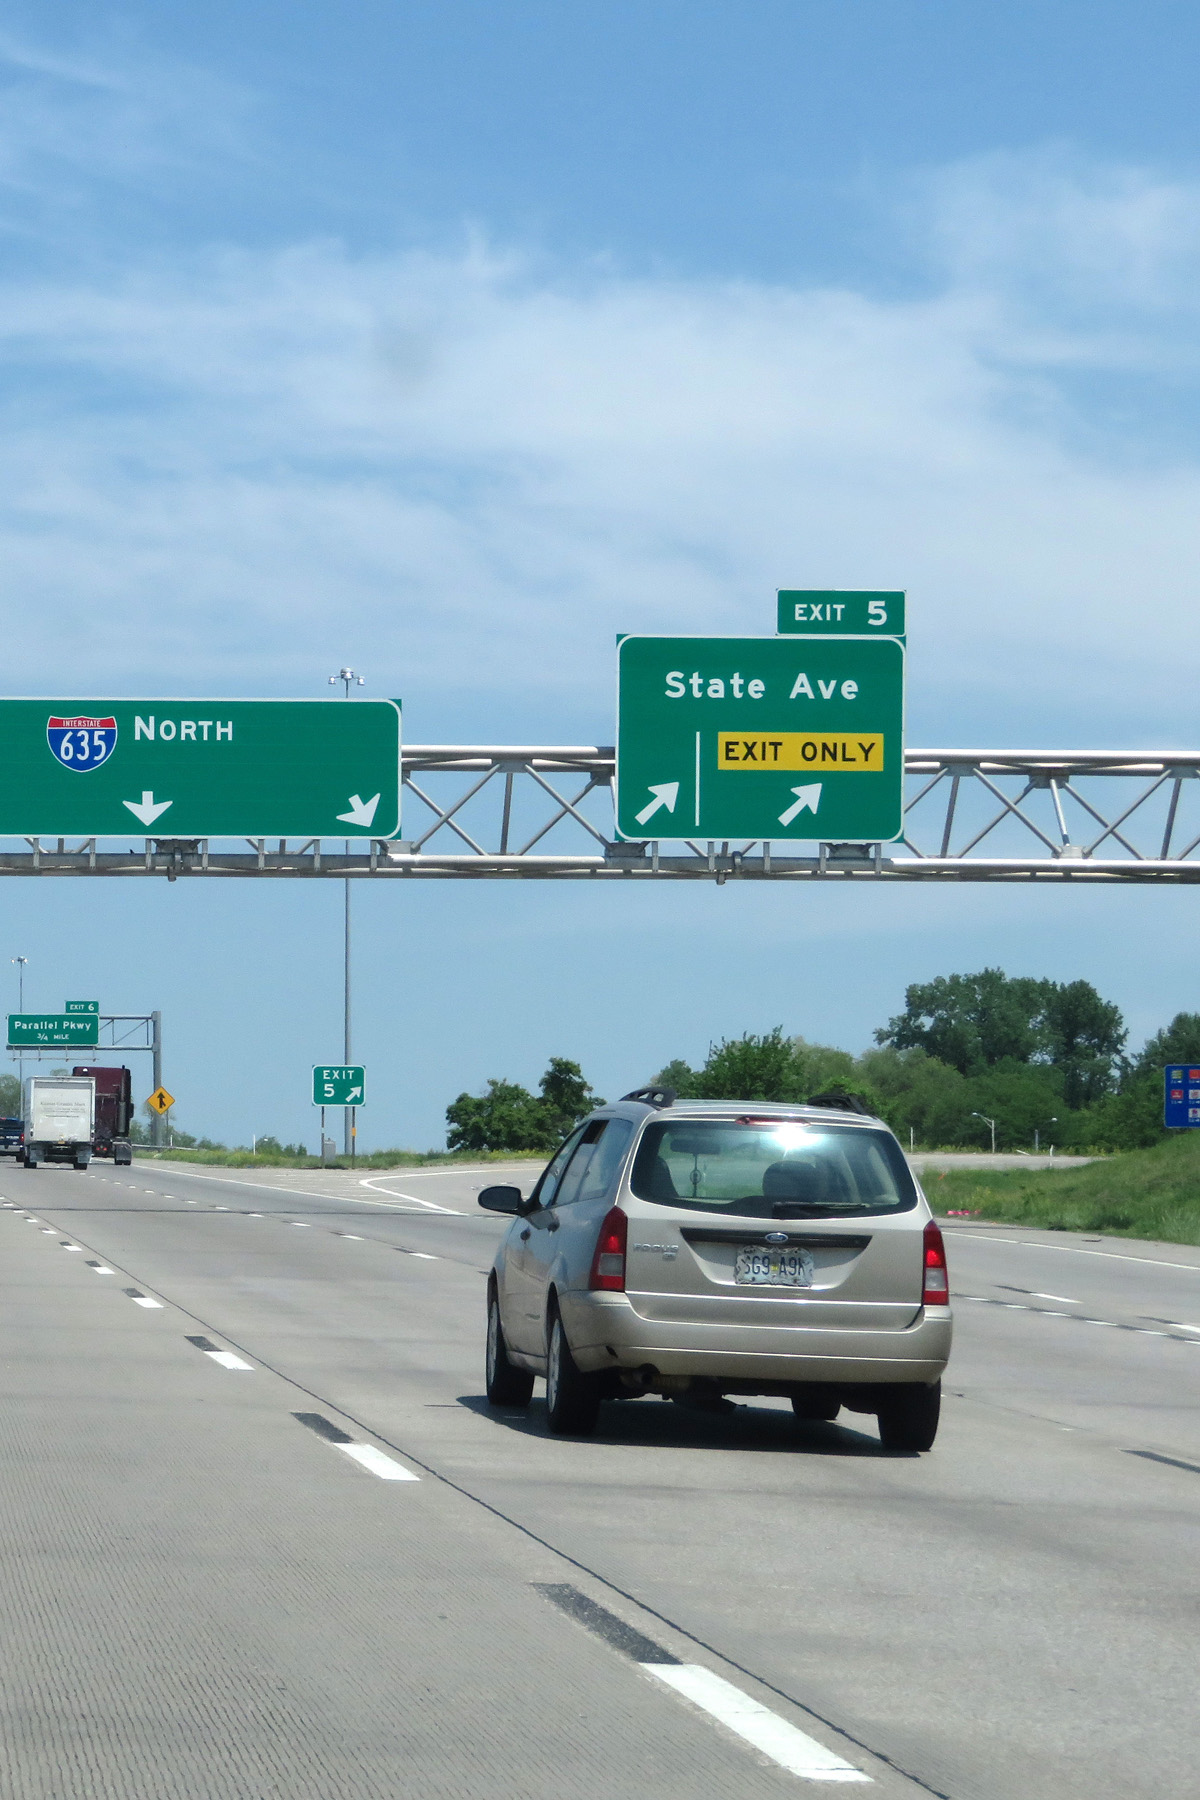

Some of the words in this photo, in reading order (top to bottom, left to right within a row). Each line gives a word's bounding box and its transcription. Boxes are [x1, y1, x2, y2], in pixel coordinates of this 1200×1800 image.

[794, 603, 845, 621] EXIT
[867, 600, 887, 626] 5
[664, 671, 766, 699] State
[789, 672, 859, 700] Ave
[62, 719, 101, 727] INTERSTATE
[134, 715, 233, 741] NORTH
[60, 730, 106, 761] 635
[724, 741, 783, 761] EXIT
[800, 742, 876, 762] ONLY
[88, 1003, 94, 1011] 6
[14, 1021, 58, 1030] Parallel
[62, 1021, 91, 1031] Pkwy
[322, 1070, 355, 1080] EXIT
[323, 1083, 335, 1097] 5
